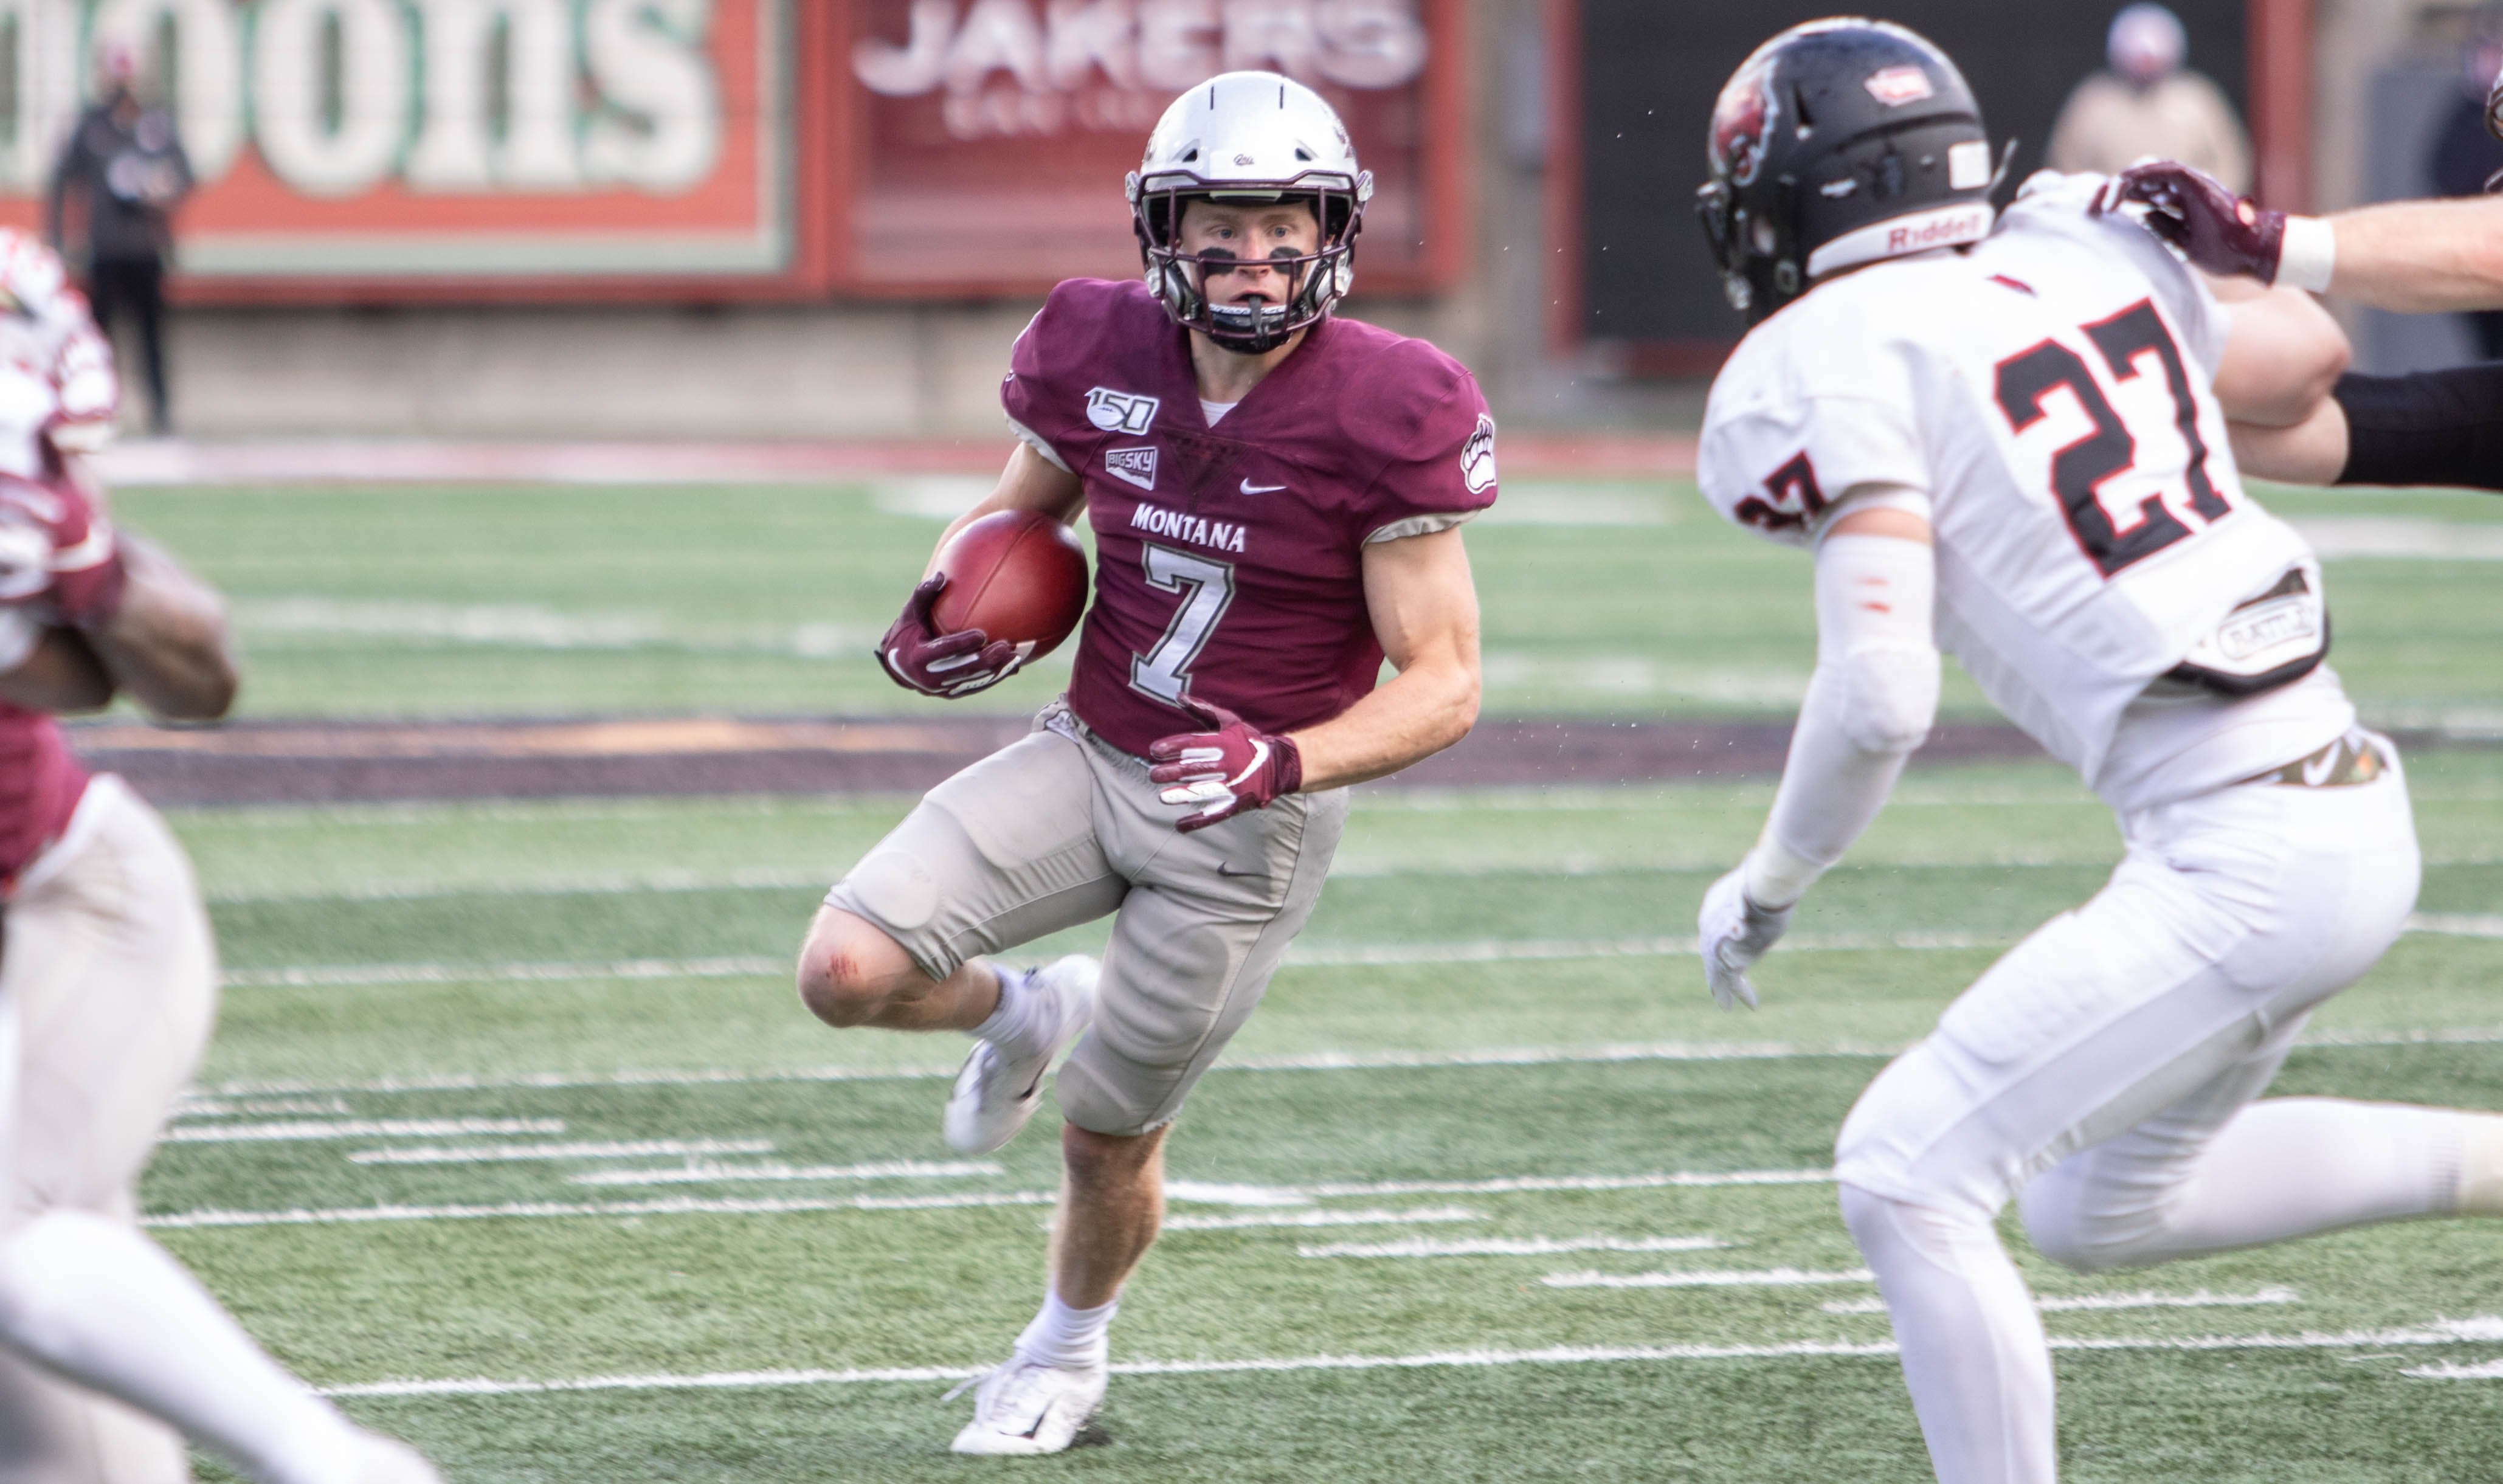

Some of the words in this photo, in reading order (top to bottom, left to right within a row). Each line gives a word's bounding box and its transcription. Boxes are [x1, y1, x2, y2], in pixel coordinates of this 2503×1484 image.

[853, 0, 1426, 96] JAKERS
[1085, 385, 1159, 435] 150
[1994, 297, 2233, 582] 27
[1130, 503, 1246, 553] MONTANA
[1129, 540, 1237, 706] 7
